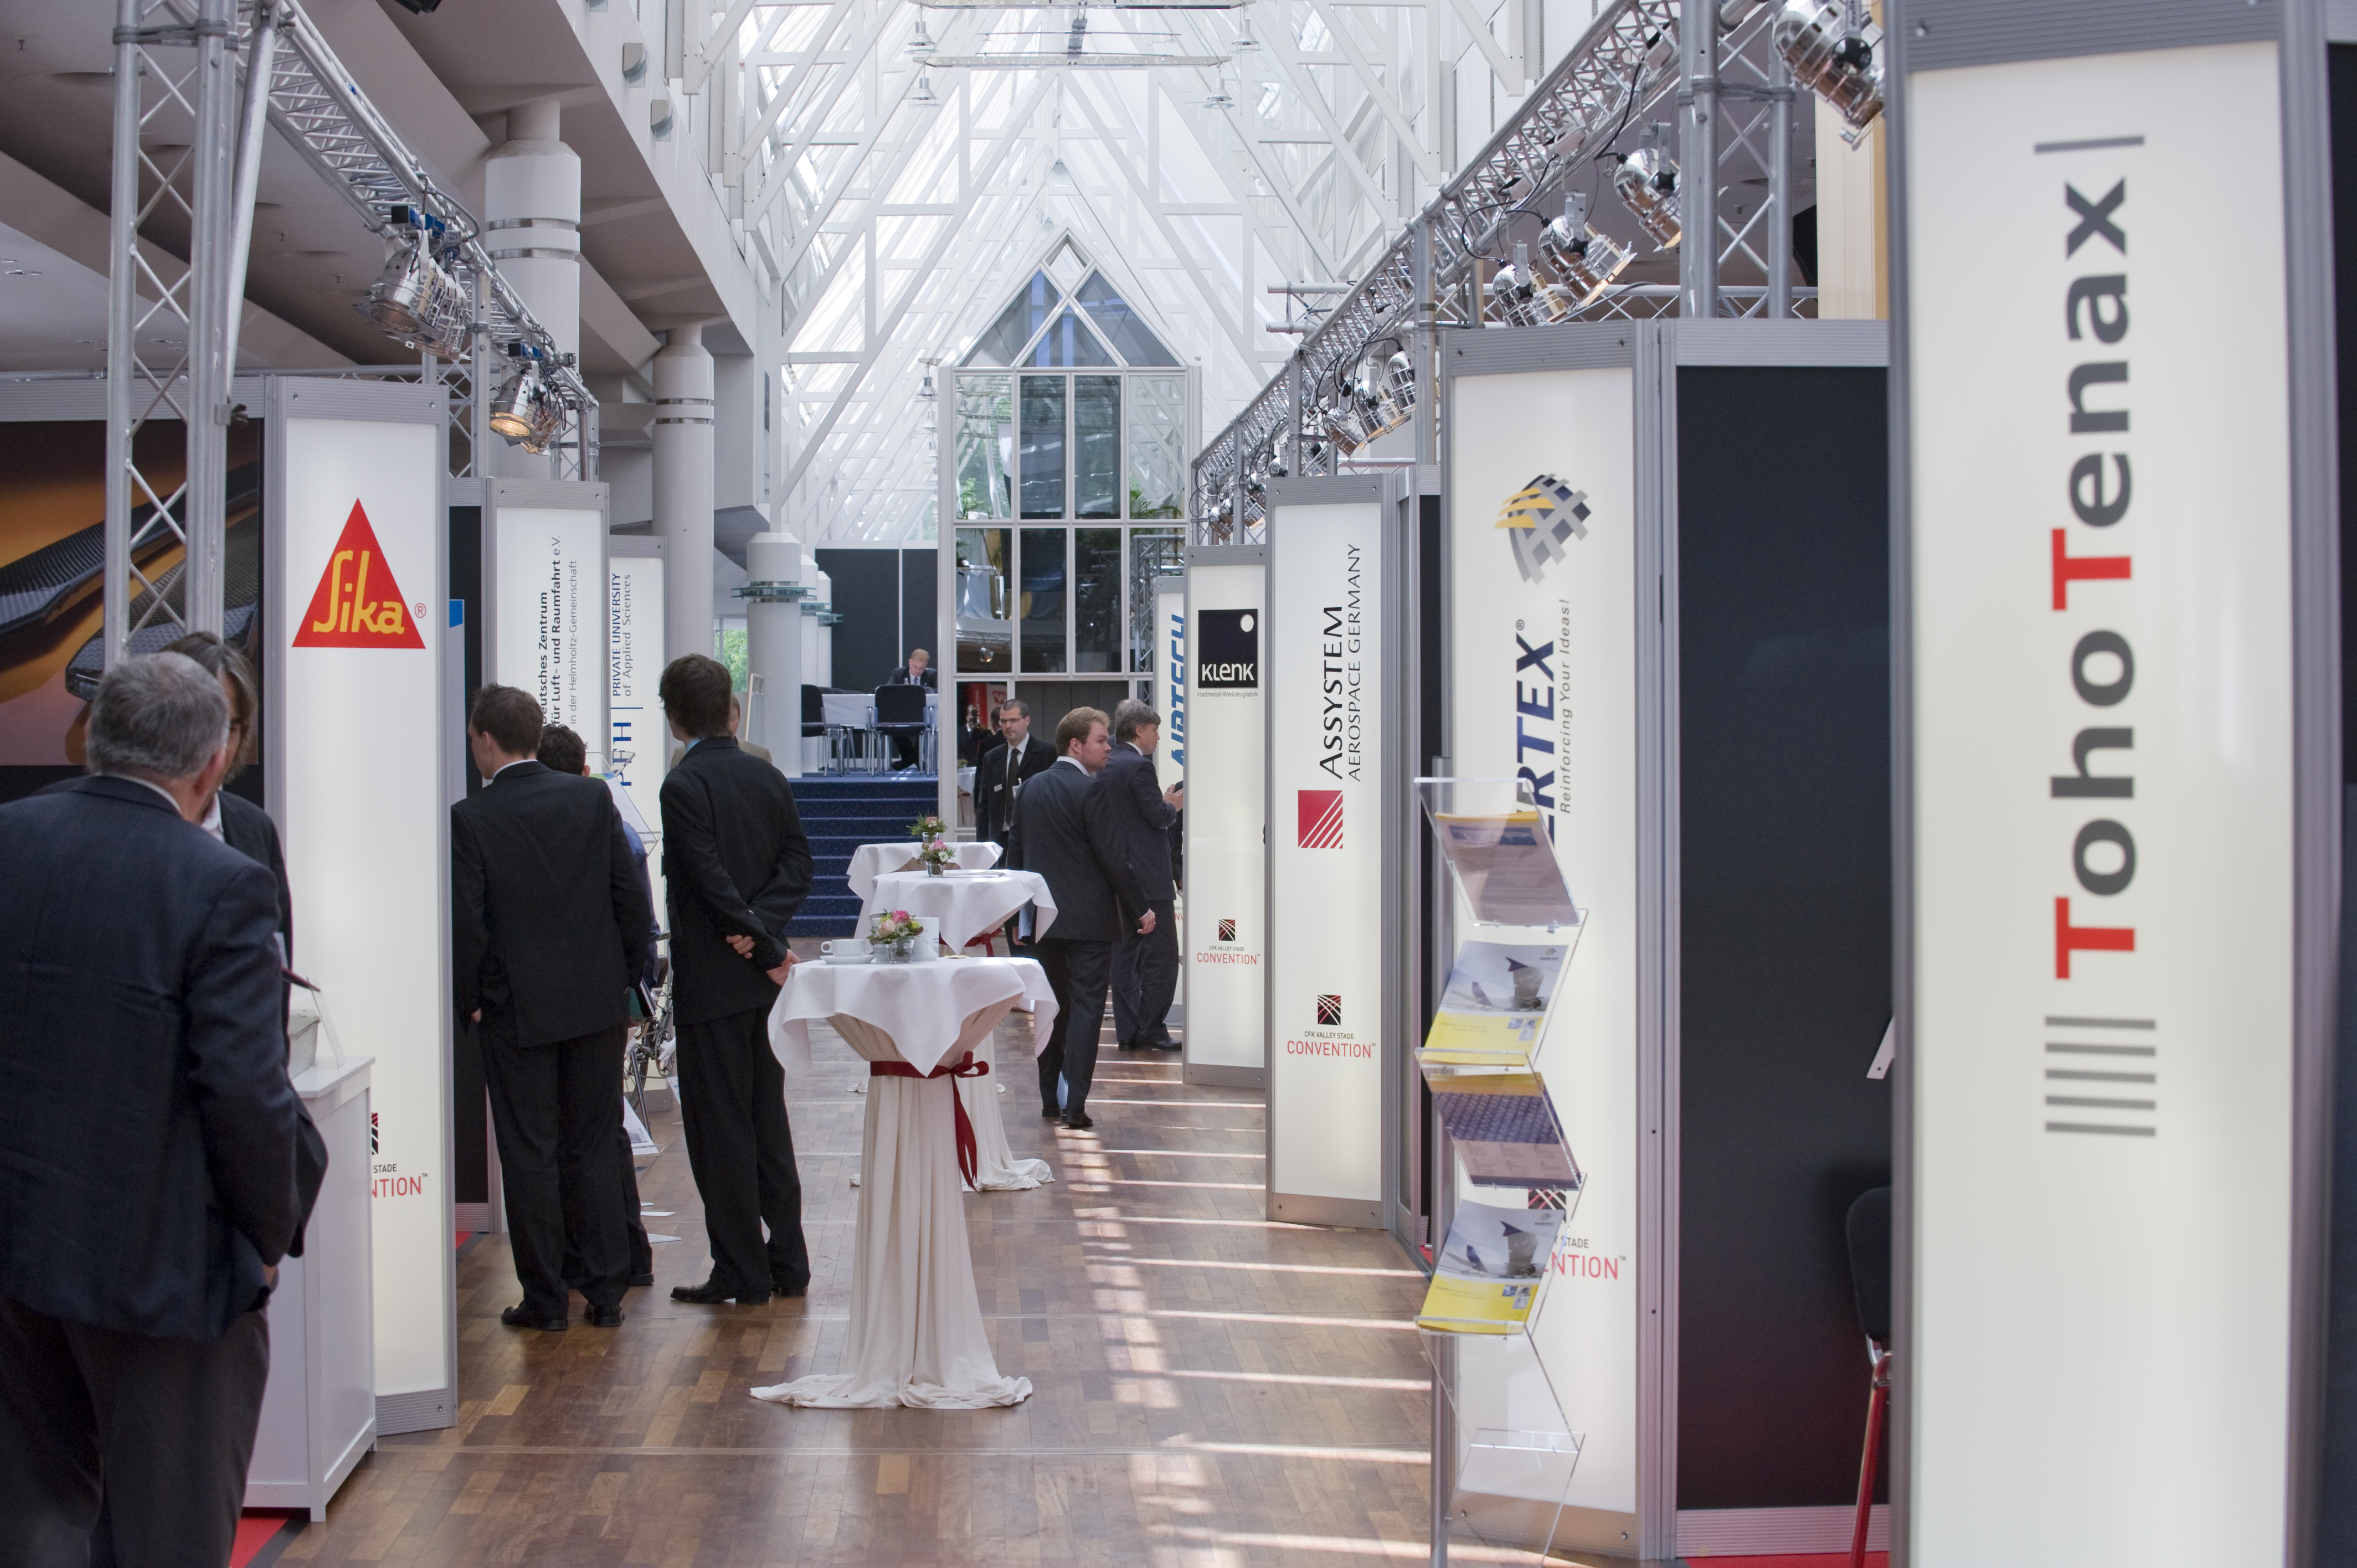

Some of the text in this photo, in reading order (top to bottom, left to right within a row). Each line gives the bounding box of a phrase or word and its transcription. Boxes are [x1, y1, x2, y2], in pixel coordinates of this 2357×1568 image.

[538, 592, 548, 650] Zentrum
[551, 536, 560, 724] für Luft- und Raumfahrt e.V.
[568, 560, 577, 724] in der Helmholtz-Gemeinschaft
[612, 573, 621, 696] PRIVATE UNIVERSITY
[622, 574, 634, 697] of Applied Sciences
[1347, 544, 1361, 782] AEROSPACE GERMANY
[1320, 607, 1342, 780] ASSYSTEM
[1559, 599, 1573, 814] Reinforcing Your Ideas!
[373, 1163, 397, 1173] STADE
[1561, 1235, 1589, 1249] STADE
